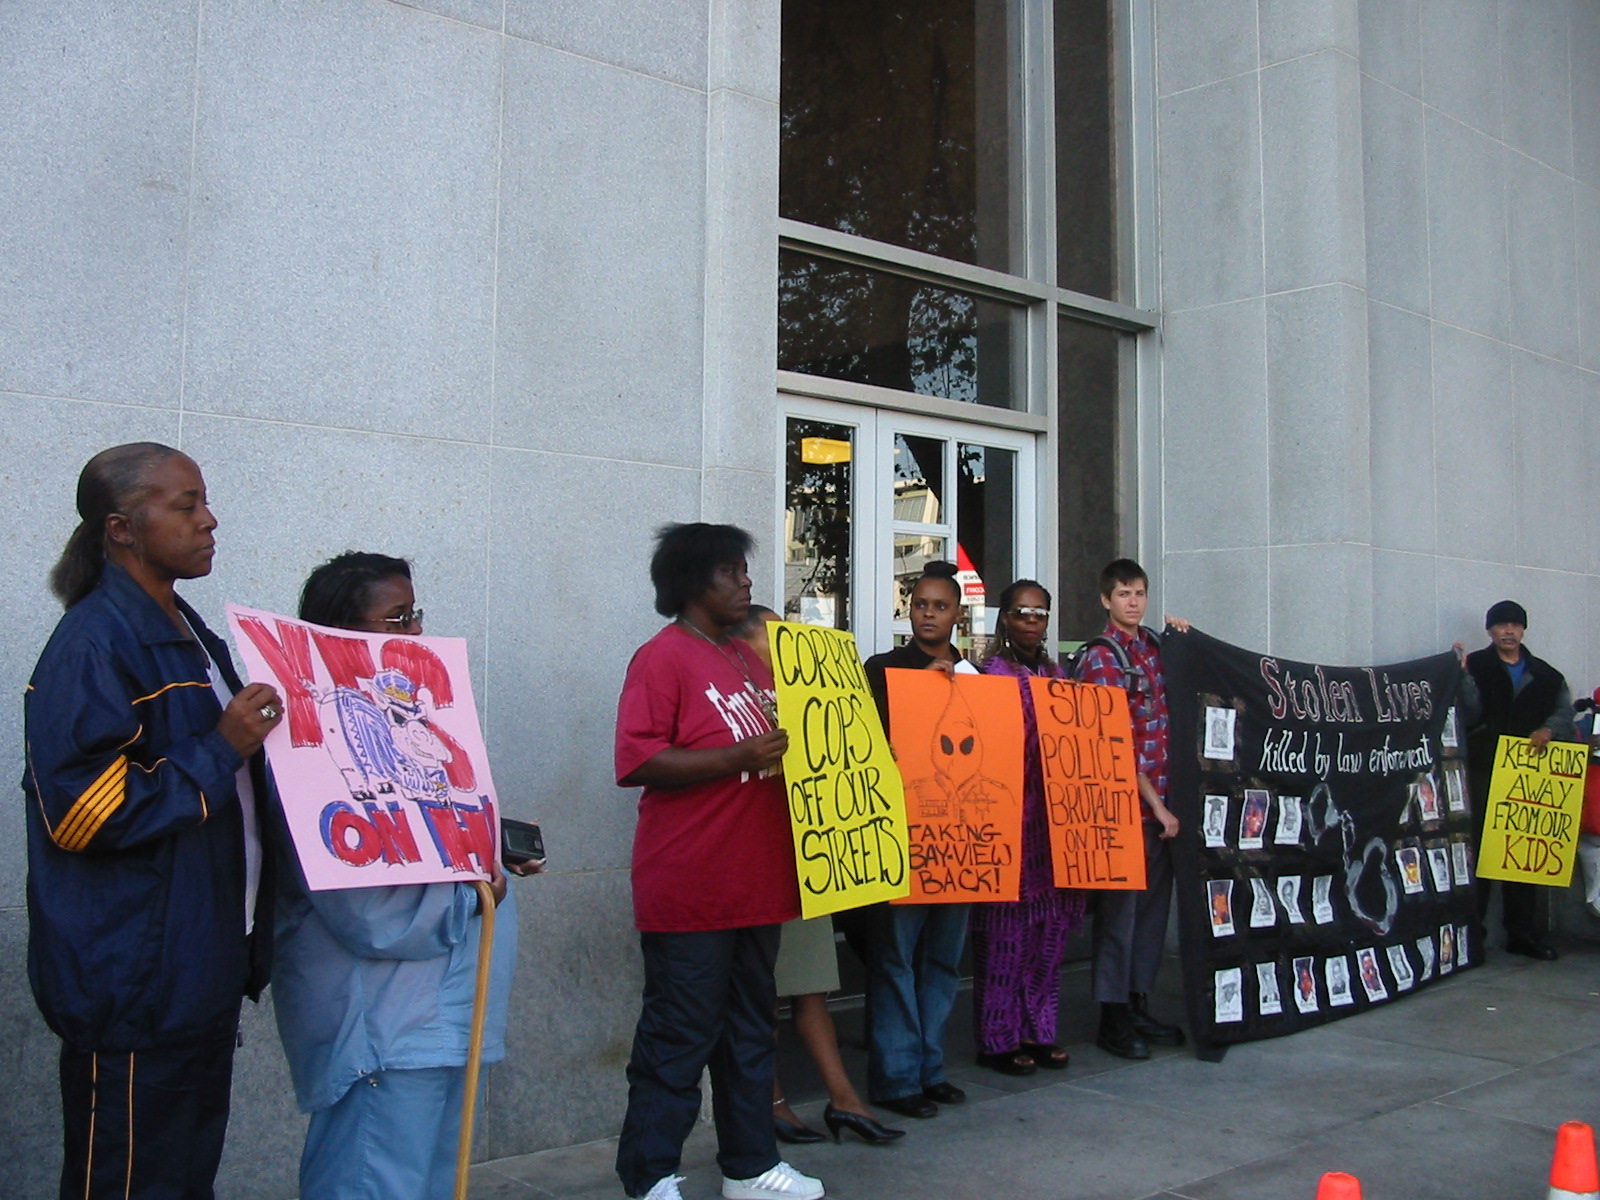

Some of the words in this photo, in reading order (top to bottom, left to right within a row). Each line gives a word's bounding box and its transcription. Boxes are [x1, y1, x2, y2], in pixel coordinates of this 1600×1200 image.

[1048, 678, 1114, 736] STOP
[1260, 657, 1363, 722] Stolen
[1361, 667, 1432, 722] Lives
[803, 693, 872, 773] COPS
[1041, 734, 1127, 781] POLICE
[1315, 732, 1331, 781] by
[1337, 733, 1363, 774] law
[1549, 746, 1586, 776] GUNS
[791, 774, 828, 826] OFF
[835, 767, 891, 822] OUR
[1047, 783, 1134, 825] BRUTALITY
[1506, 774, 1574, 809] AWAY
[319, 801, 423, 868] ON
[907, 823, 1002, 843] TAKING
[1065, 828, 1088, 853] ON
[1090, 825, 1124, 850] THE
[1492, 802, 1540, 836] FROM
[1540, 810, 1572, 842] OUR
[801, 816, 904, 894] STREETS
[1064, 851, 1127, 885] HILL
[1501, 835, 1564, 875] KIDS
[918, 868, 1000, 895] BACK!
